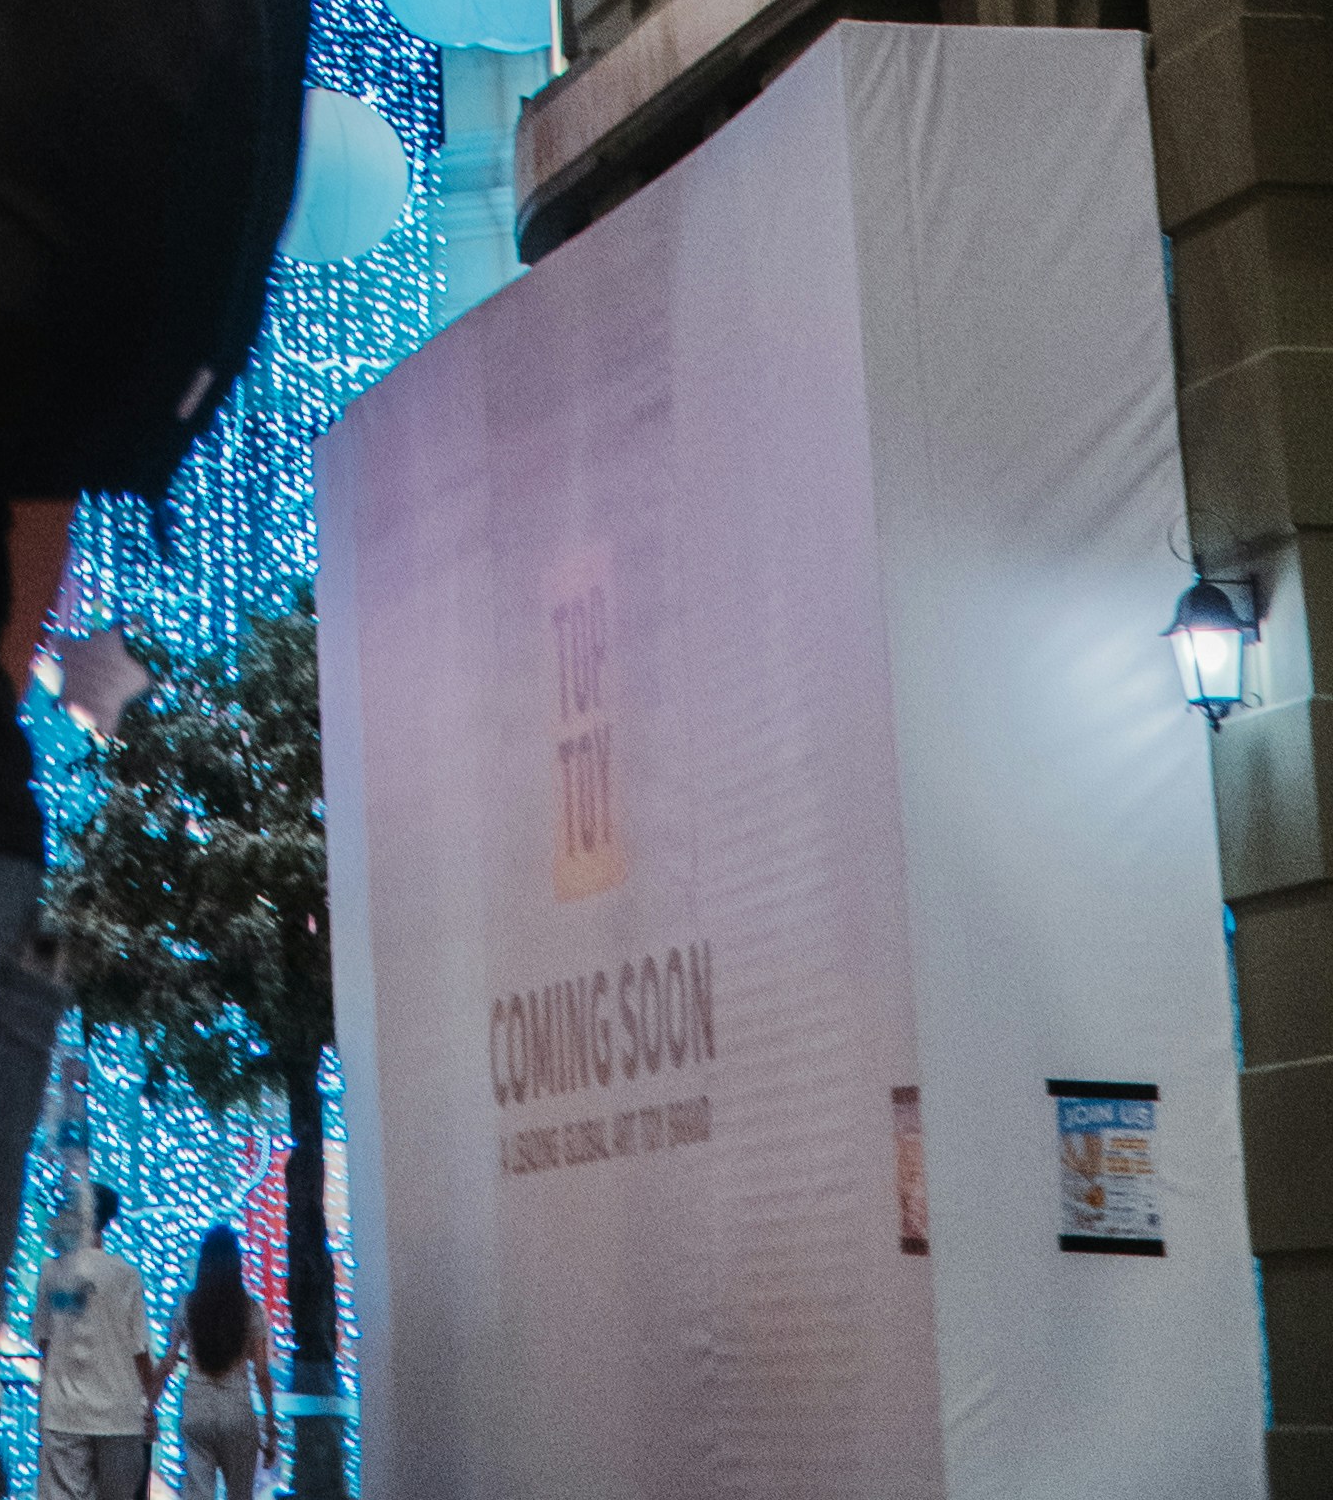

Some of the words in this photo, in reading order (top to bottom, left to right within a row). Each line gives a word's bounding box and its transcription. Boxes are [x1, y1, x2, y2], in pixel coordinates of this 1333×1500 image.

[489, 968, 613, 1108] COMING
[618, 938, 716, 1082] SOON
[1064, 1104, 1114, 1128] JOIN
[1118, 1103, 1151, 1126] US
